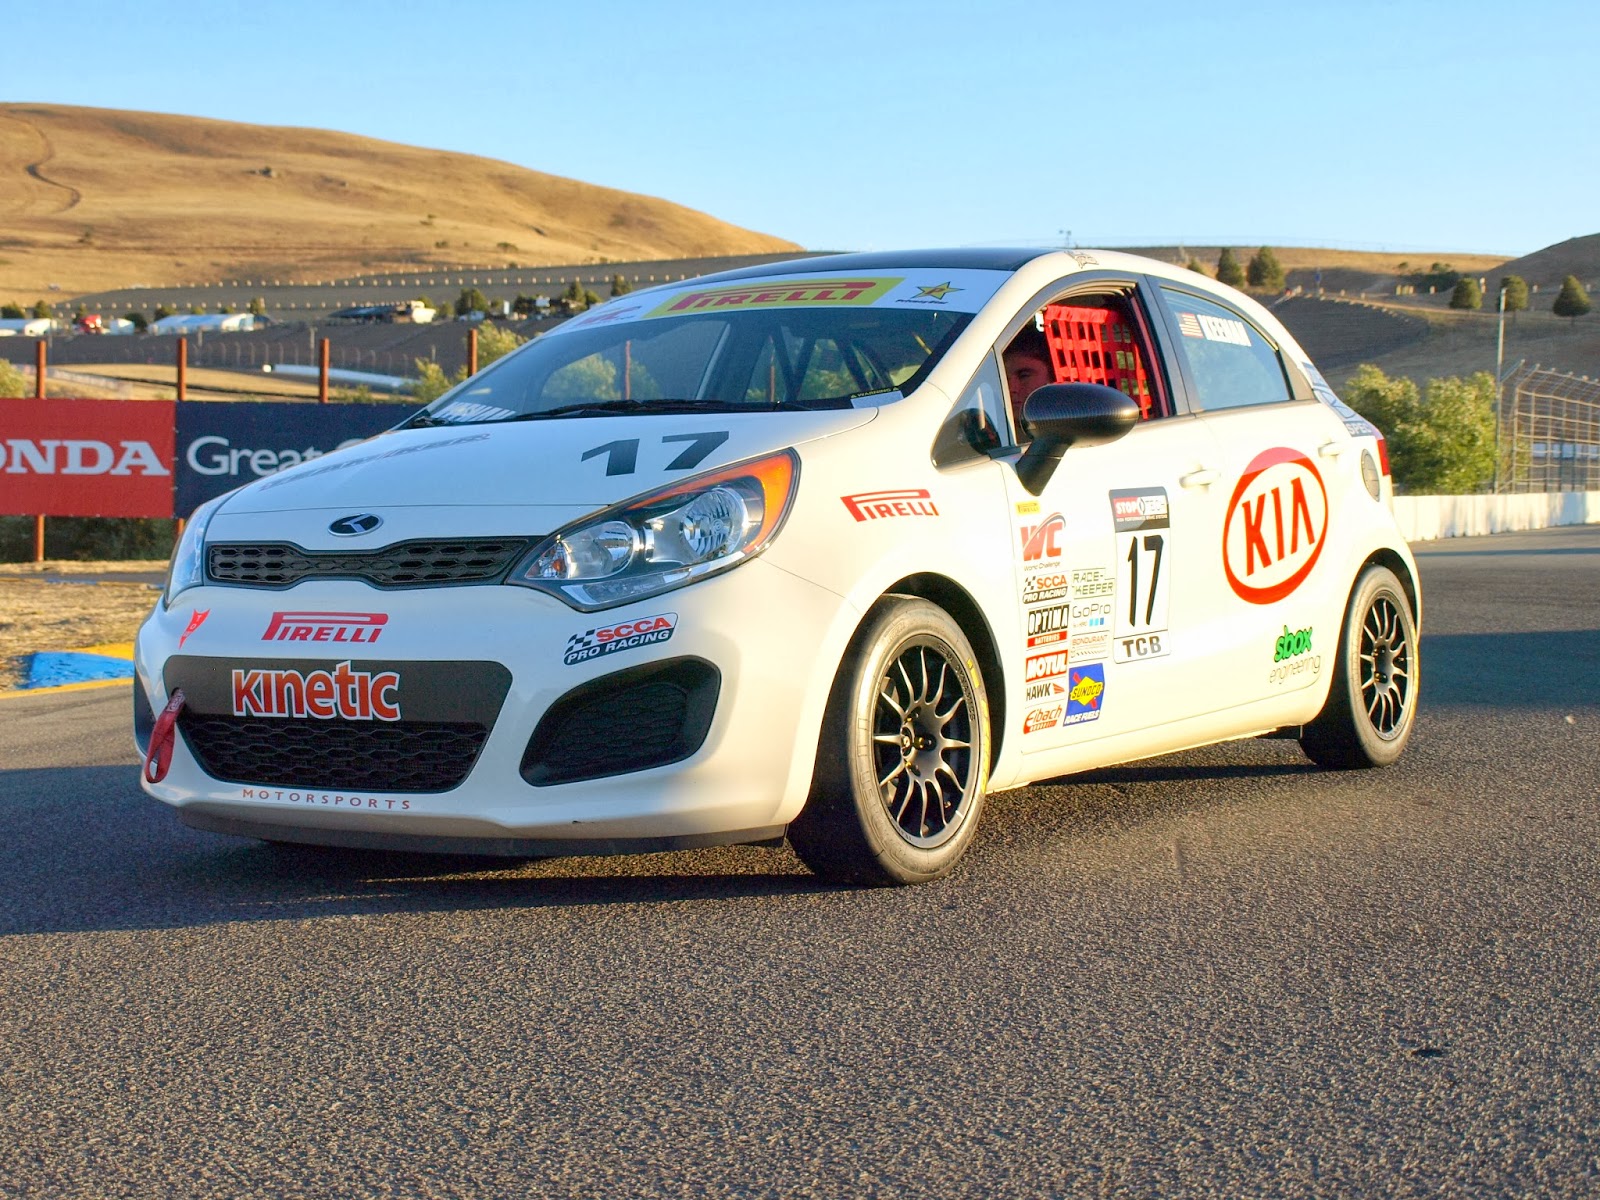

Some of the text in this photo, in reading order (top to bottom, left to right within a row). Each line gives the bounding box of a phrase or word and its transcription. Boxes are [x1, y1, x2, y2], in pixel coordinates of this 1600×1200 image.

[667, 281, 877, 312] PIRELLI
[0, 438, 171, 476] NDA
[581, 431, 729, 477] 17
[840, 489, 939, 522] PIRELLI
[1241, 477, 1316, 576] KIA
[1024, 587, 1066, 603] PRO RACING
[1036, 575, 1067, 590] SCCA
[1127, 534, 1164, 627] 17
[1028, 606, 1069, 635] OPTIMA
[1072, 603, 1111, 618] GoPro
[261, 611, 389, 643] PIRELLI
[596, 617, 672, 642] SCCA
[567, 630, 670, 664] PRO RACING
[1122, 635, 1162, 657] TCB
[1274, 624, 1313, 663] sbox
[1027, 652, 1066, 680] MOTUL
[1269, 655, 1321, 685] engineering
[1026, 683, 1051, 701] HAWK
[1071, 684, 1102, 699] SUNOCO
[1064, 713, 1082, 724] RACE
[242, 788, 411, 810] MOTORSPORTS
